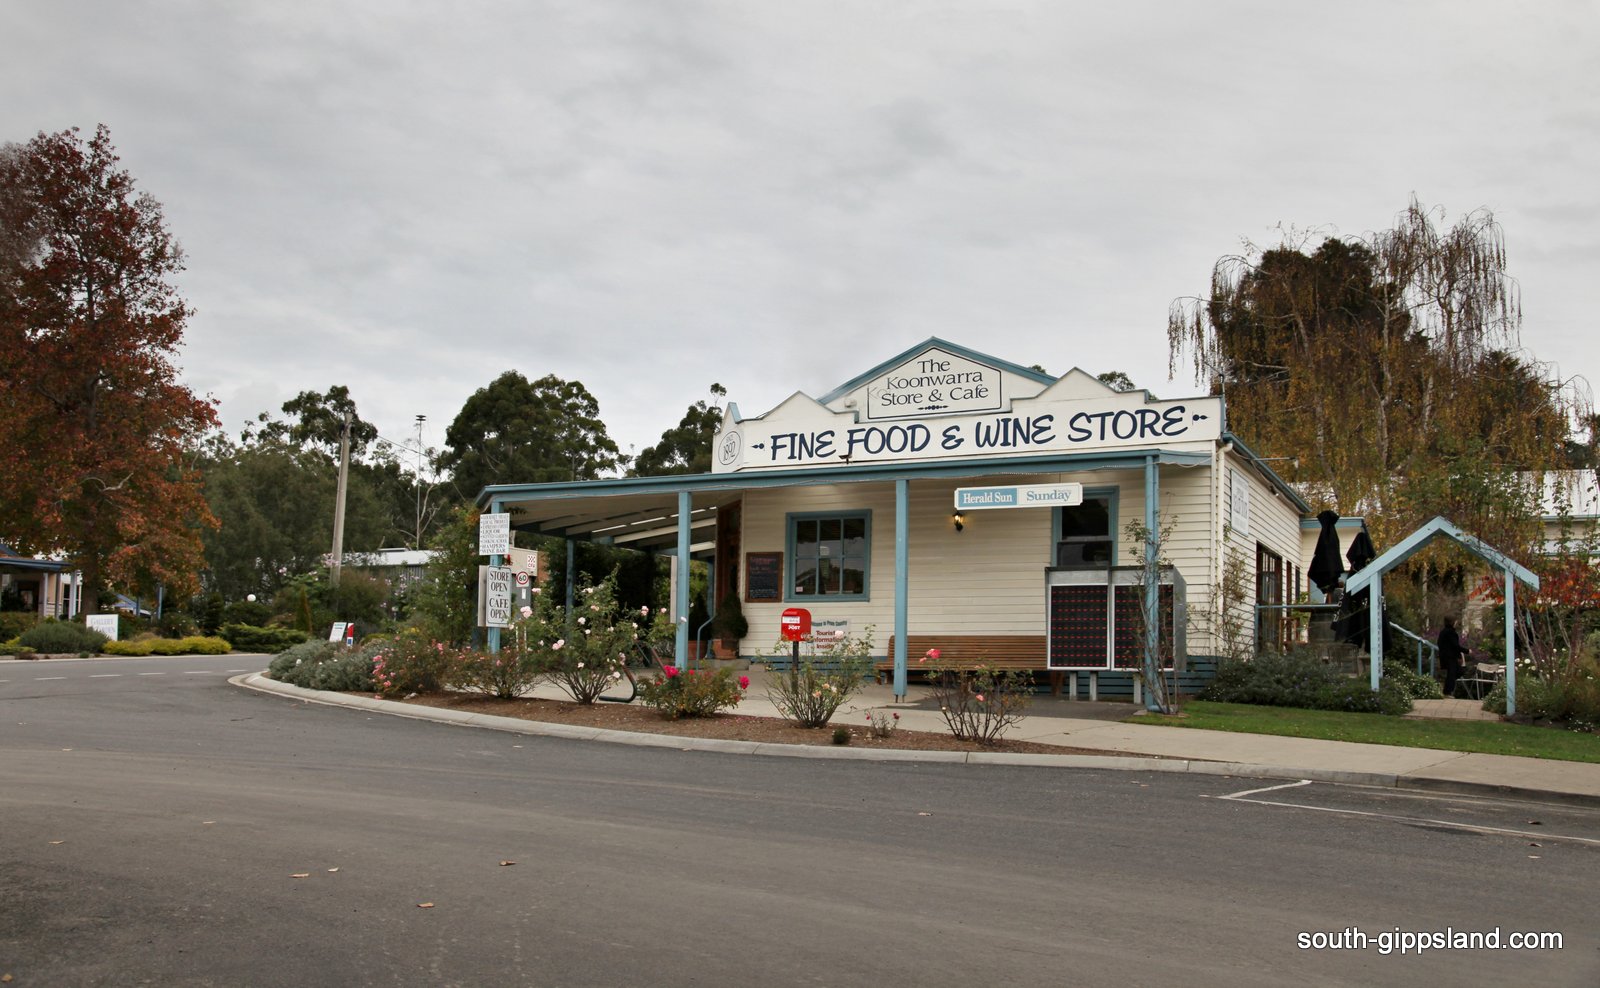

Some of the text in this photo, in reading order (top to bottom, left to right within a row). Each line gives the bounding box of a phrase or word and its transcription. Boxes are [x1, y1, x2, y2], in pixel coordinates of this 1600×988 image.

[917, 359, 951, 374] The
[886, 371, 983, 390] Koonwarra
[881, 392, 923, 407] Store
[928, 389, 942, 402] &
[949, 384, 989, 401] Cafe
[770, 405, 1188, 461] FINE FOOD & WINE STORE
[963, 491, 1013, 504] Herald Sun
[1026, 489, 1072, 502] Sunday
[489, 570, 509, 582] STORE
[490, 582, 508, 592] OPEN
[489, 597, 509, 609] CAFE
[490, 608, 508, 619] OPEN
